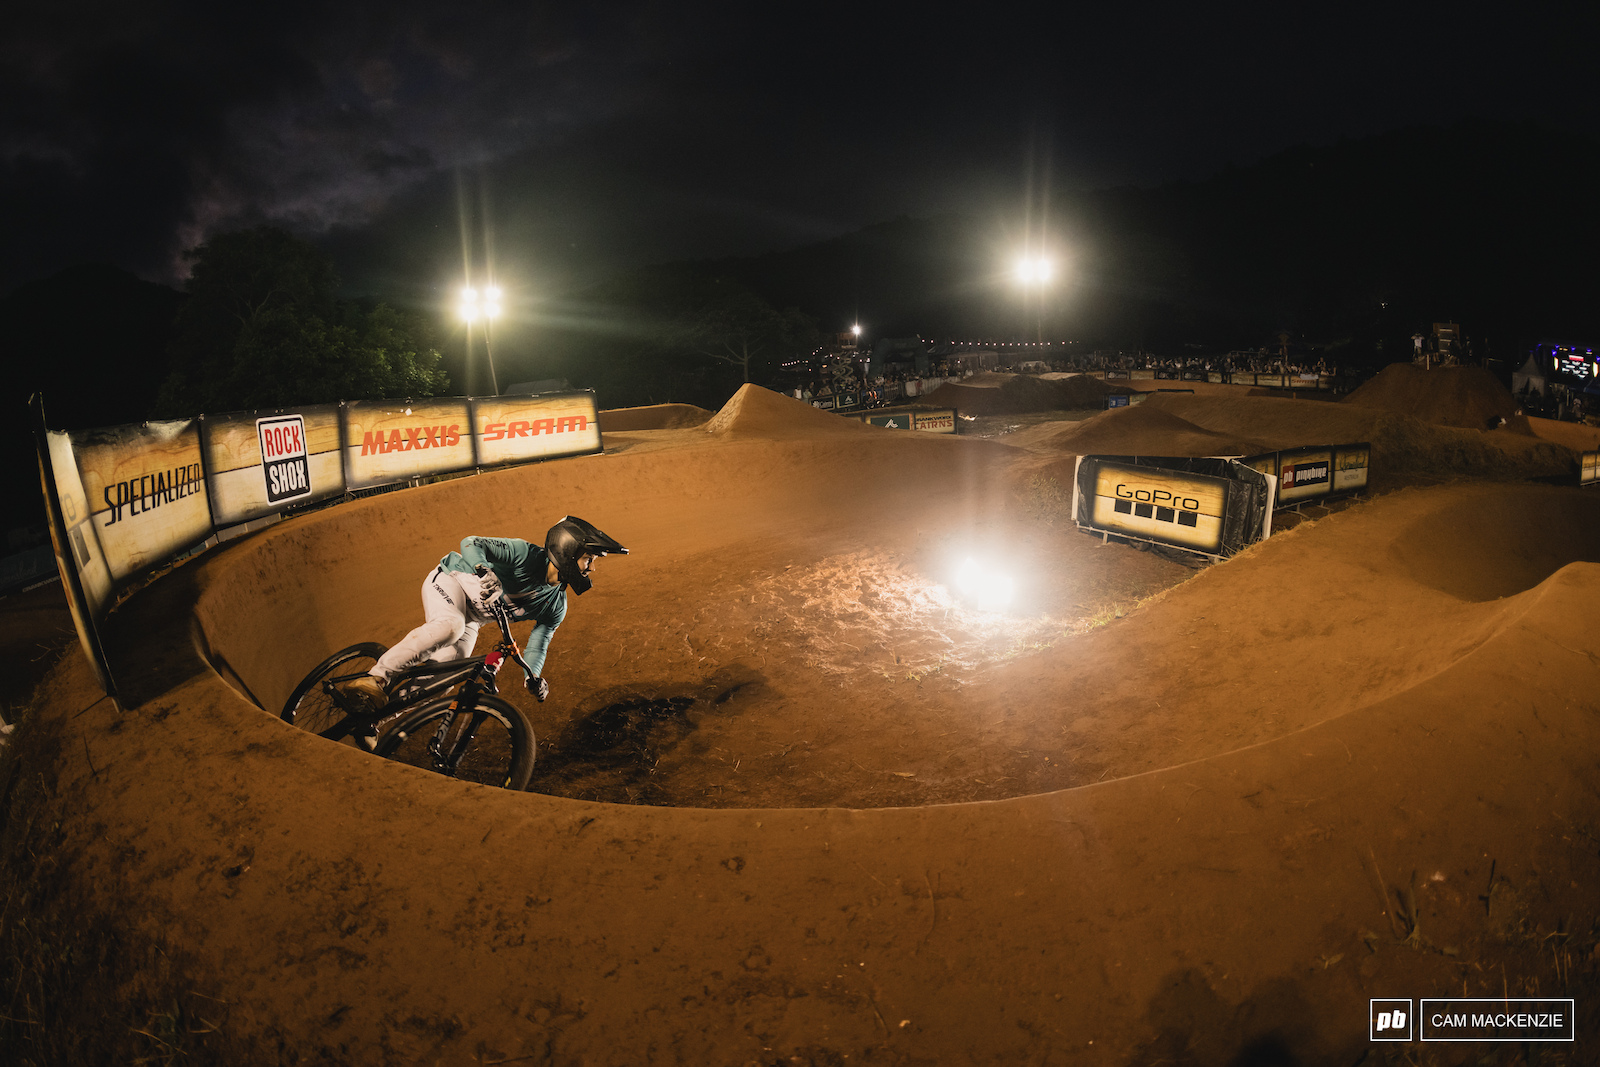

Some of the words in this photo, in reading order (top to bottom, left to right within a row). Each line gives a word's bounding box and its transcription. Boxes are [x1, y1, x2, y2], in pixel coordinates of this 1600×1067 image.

[265, 426, 302, 455] ROCK
[361, 423, 461, 457] MAXXIS
[483, 415, 588, 442] SRAM
[268, 458, 307, 496] SHOX
[1283, 470, 1294, 485] pb
[104, 463, 201, 528] SPECIALIZED
[1115, 483, 1199, 511] GoPro
